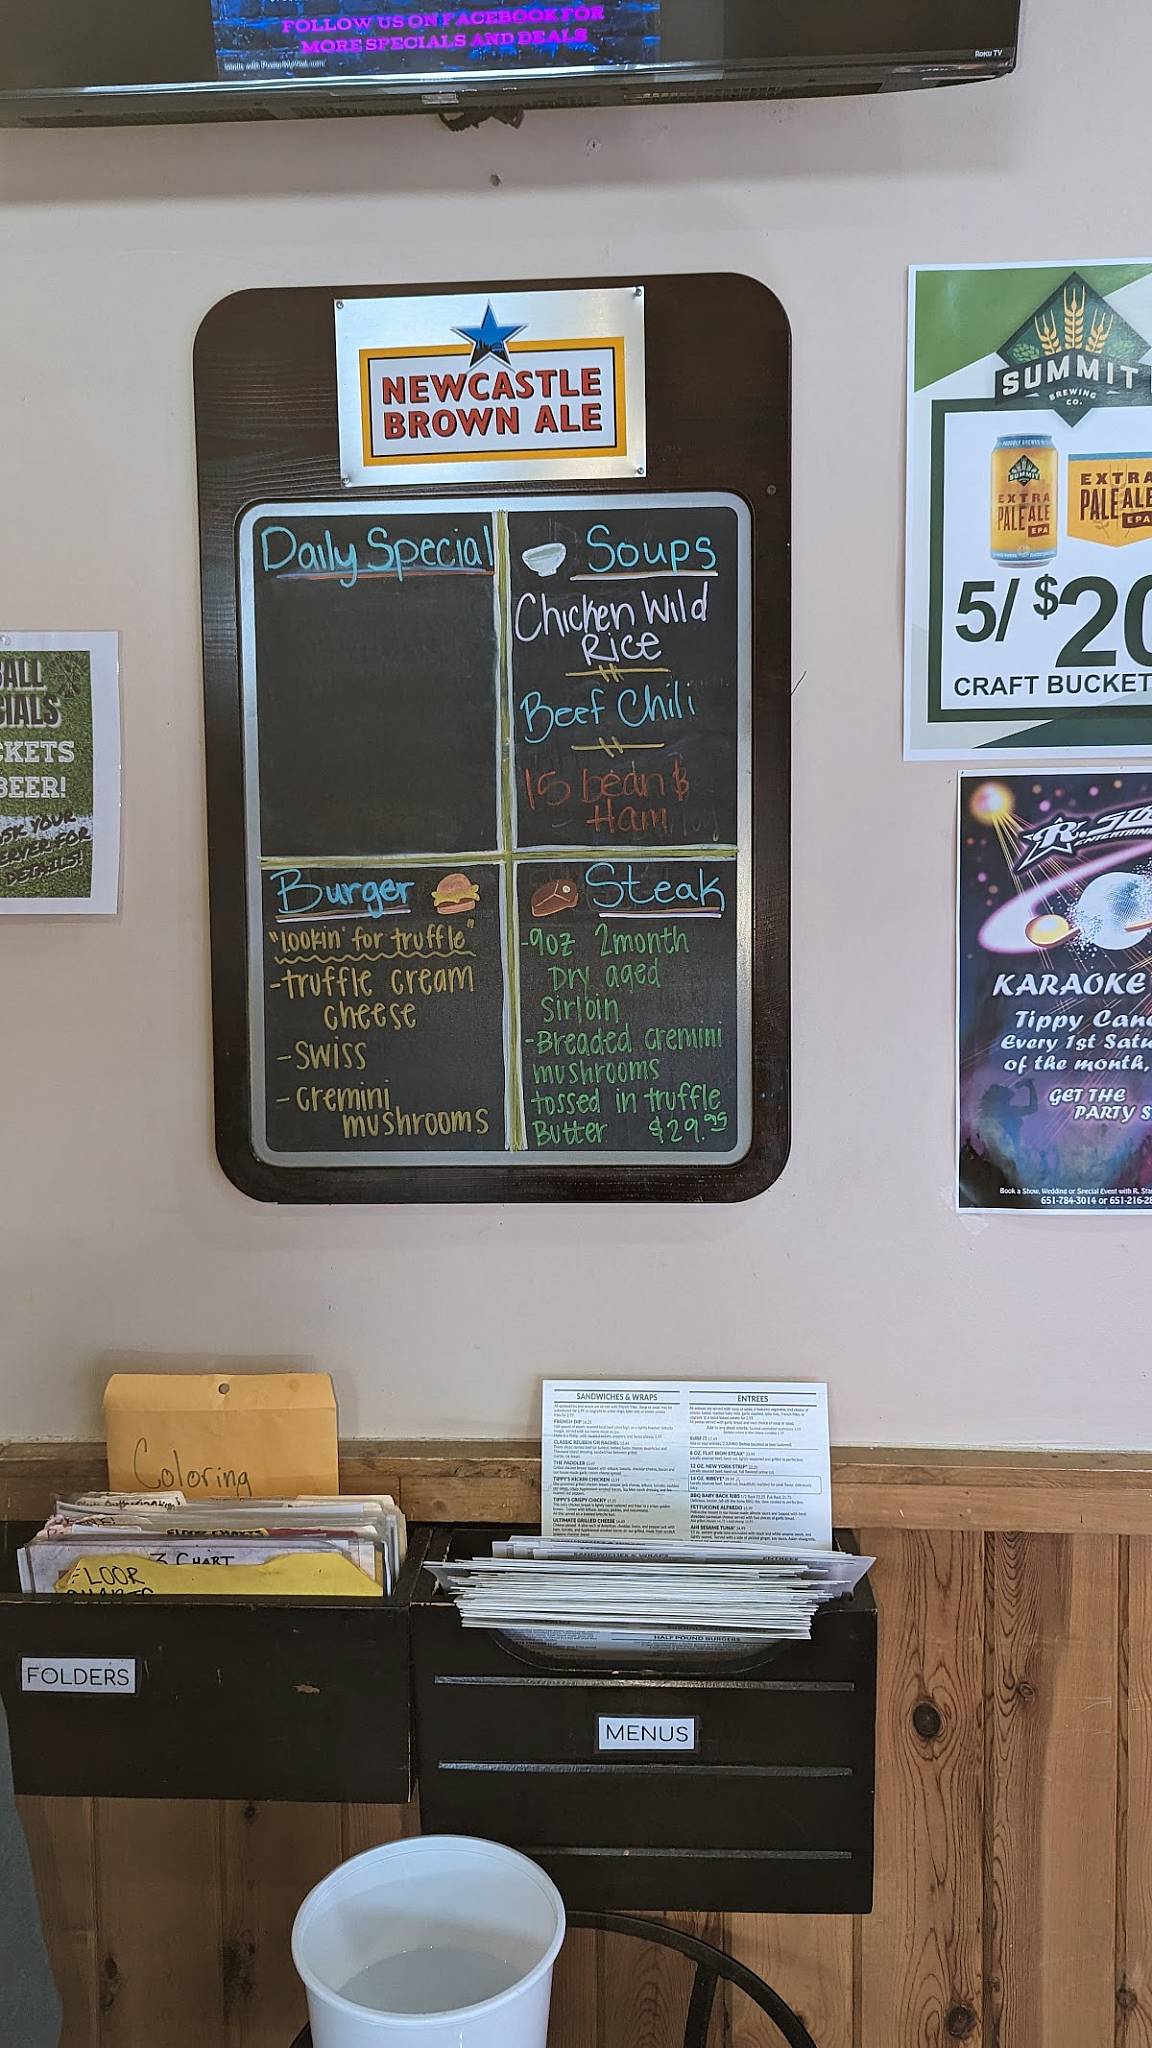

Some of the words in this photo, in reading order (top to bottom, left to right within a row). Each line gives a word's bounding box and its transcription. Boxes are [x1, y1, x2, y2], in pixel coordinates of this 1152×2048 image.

[281, 15, 372, 33] FOLLOW
[378, 14, 404, 30] US
[408, 14, 438, 29] ON
[440, 8, 561, 27] FACEBOOK
[561, 5, 605, 21] FOR
[301, 38, 363, 54] MORE
[365, 33, 467, 51] SPECIALS
[471, 32, 515, 47] AND
[518, 28, 588, 45] DEALS
[382, 367, 602, 405] NEWCASTLE
[1002, 354, 1139, 397] SUMMIT
[1048, 387, 1097, 402] BREWING
[1066, 398, 1082, 406] CO.
[384, 406, 520, 440] BROWN
[535, 402, 602, 433] ALE
[1009, 471, 1039, 481] SUMMIT
[1080, 471, 1152, 485] EXTRA
[998, 492, 1050, 503] EXTRA
[1080, 488, 1119, 520] PALE
[1122, 487, 1152, 508] ALE
[997, 505, 1025, 531] PALE
[1028, 504, 1050, 522] ALE
[1031, 526, 1048, 535] EPA
[1127, 516, 1151, 524] EPA
[261, 526, 357, 588] Daily
[367, 525, 493, 581] Special
[586, 524, 717, 575] Soups
[515, 592, 635, 642] Chicken
[641, 581, 709, 624] Wild
[581, 632, 662, 666] Rice
[0, 658, 46, 689] ALL
[954, 676, 1039, 696] CRAFT
[520, 688, 605, 744] Beef
[617, 681, 695, 729] Chili
[0, 741, 75, 763] KETS
[30, 809, 77, 834] YOUR
[586, 799, 668, 834] Ham
[55, 826, 92, 849] FOR
[270, 869, 415, 918] Burger
[585, 862, 726, 911] Steak
[352, 926, 384, 951] for
[391, 965, 474, 996] cream
[547, 966, 590, 998] Dry
[605, 957, 662, 994] aged
[992, 972, 1147, 997] KARAOKE
[323, 1001, 417, 1031] cheese
[540, 993, 619, 1024] Sirloin
[1015, 1010, 1084, 1032] Tippy
[1001, 1034, 1058, 1053] Every
[1065, 1033, 1096, 1051] 1st
[533, 1058, 660, 1085] mushrooms
[1004, 1055, 1028, 1075] of
[1034, 1055, 1067, 1071] the
[1074, 1054, 1150, 1072] month,
[530, 1087, 601, 1115] tossed
[615, 1087, 637, 1114] in
[644, 1081, 721, 1112] truffle
[1049, 1088, 1084, 1105] GET
[1087, 1088, 1126, 1103] THE
[343, 1106, 489, 1139] mushrooms
[1074, 1105, 1136, 1123] PARTY
[532, 1120, 608, 1147] Butter
[999, 1187, 1016, 1195] Book
[1022, 1187, 1041, 1196] Show,
[1041, 1187, 1067, 1196] Wedding
[1077, 1187, 1099, 1196] Special
[1100, 1187, 1117, 1195] Event
[1118, 1187, 1132, 1195] with
[1041, 1196, 1096, 1205] 651-784-3014
[576, 1393, 624, 1401] SANDWICHES
[632, 1393, 658, 1401] WRAPS
[132, 1437, 253, 1497] Coloring
[176, 1552, 235, 1566] CHART
[27, 1667, 130, 1687] FOLDERS
[606, 1724, 689, 1743] MENUS
